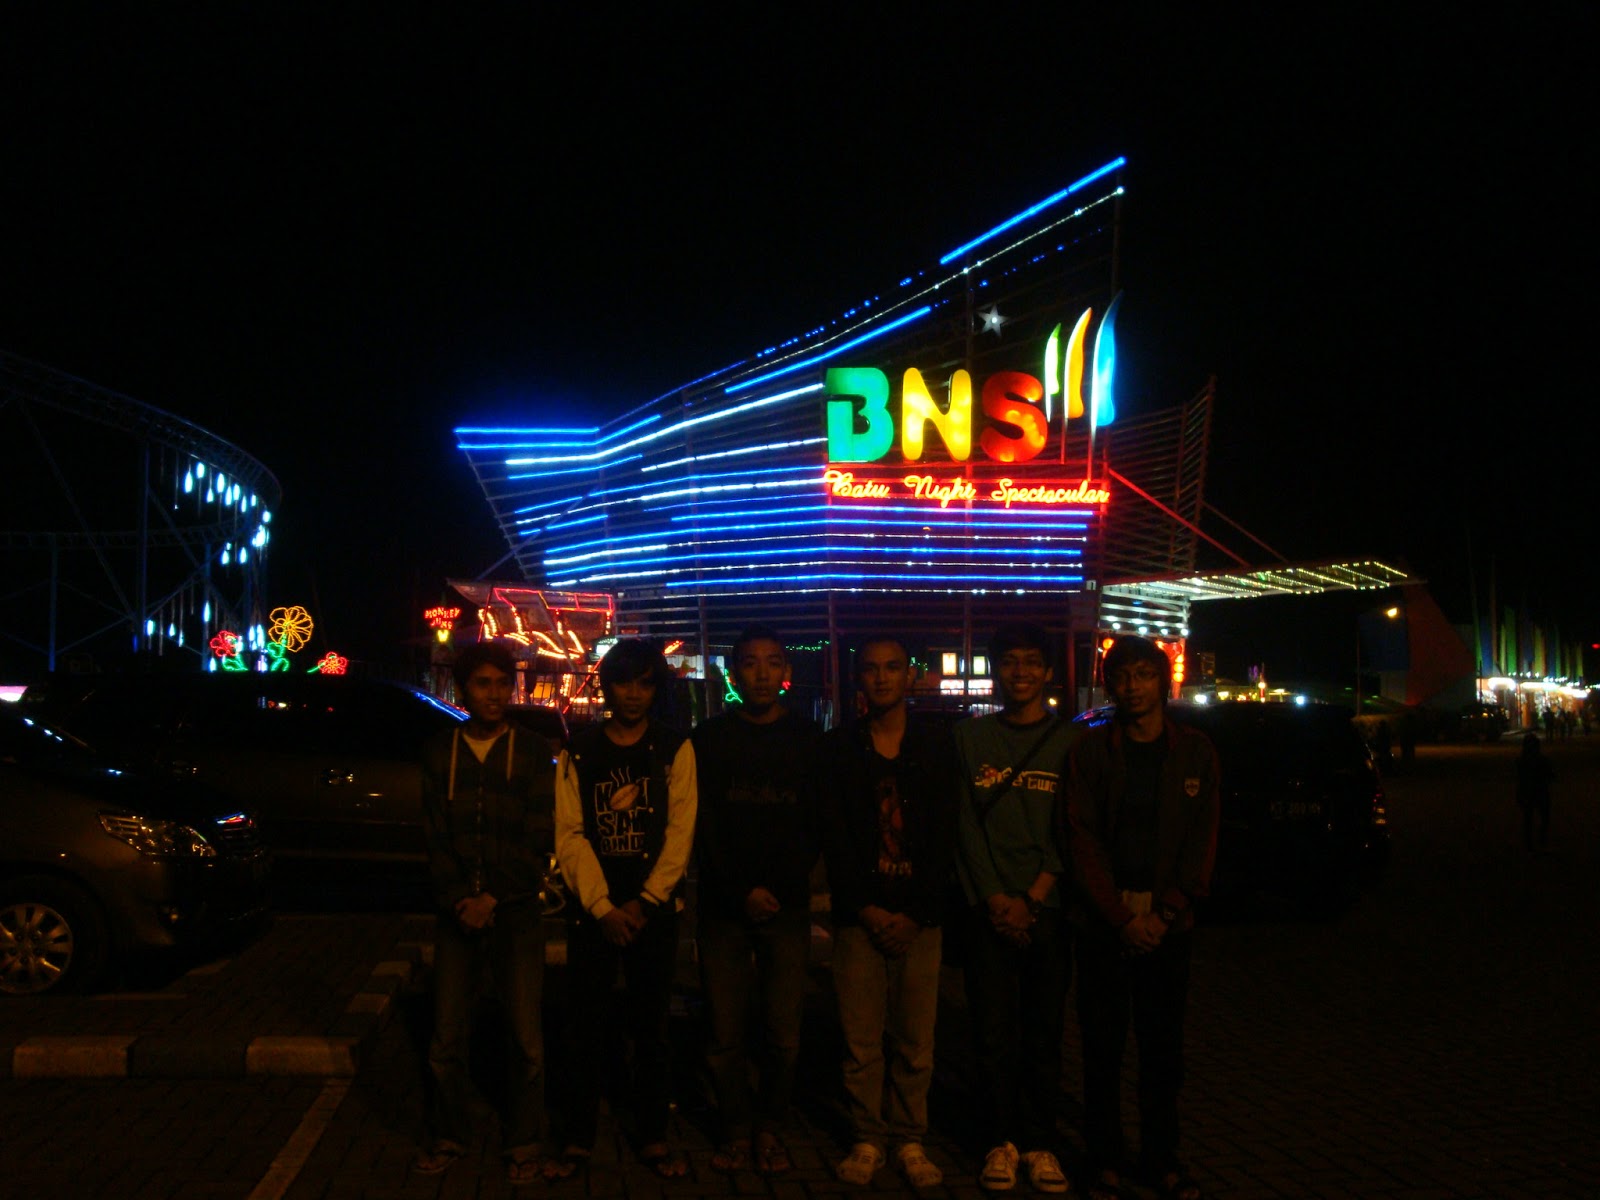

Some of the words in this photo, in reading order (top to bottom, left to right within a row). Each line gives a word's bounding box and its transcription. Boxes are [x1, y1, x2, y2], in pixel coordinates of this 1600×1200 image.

[825, 367, 1049, 463] BNS
[823, 470, 890, 499] Batu
[903, 476, 977, 508] Night
[991, 479, 1110, 509] Spectacular
[424, 606, 461, 619] MONKEY
